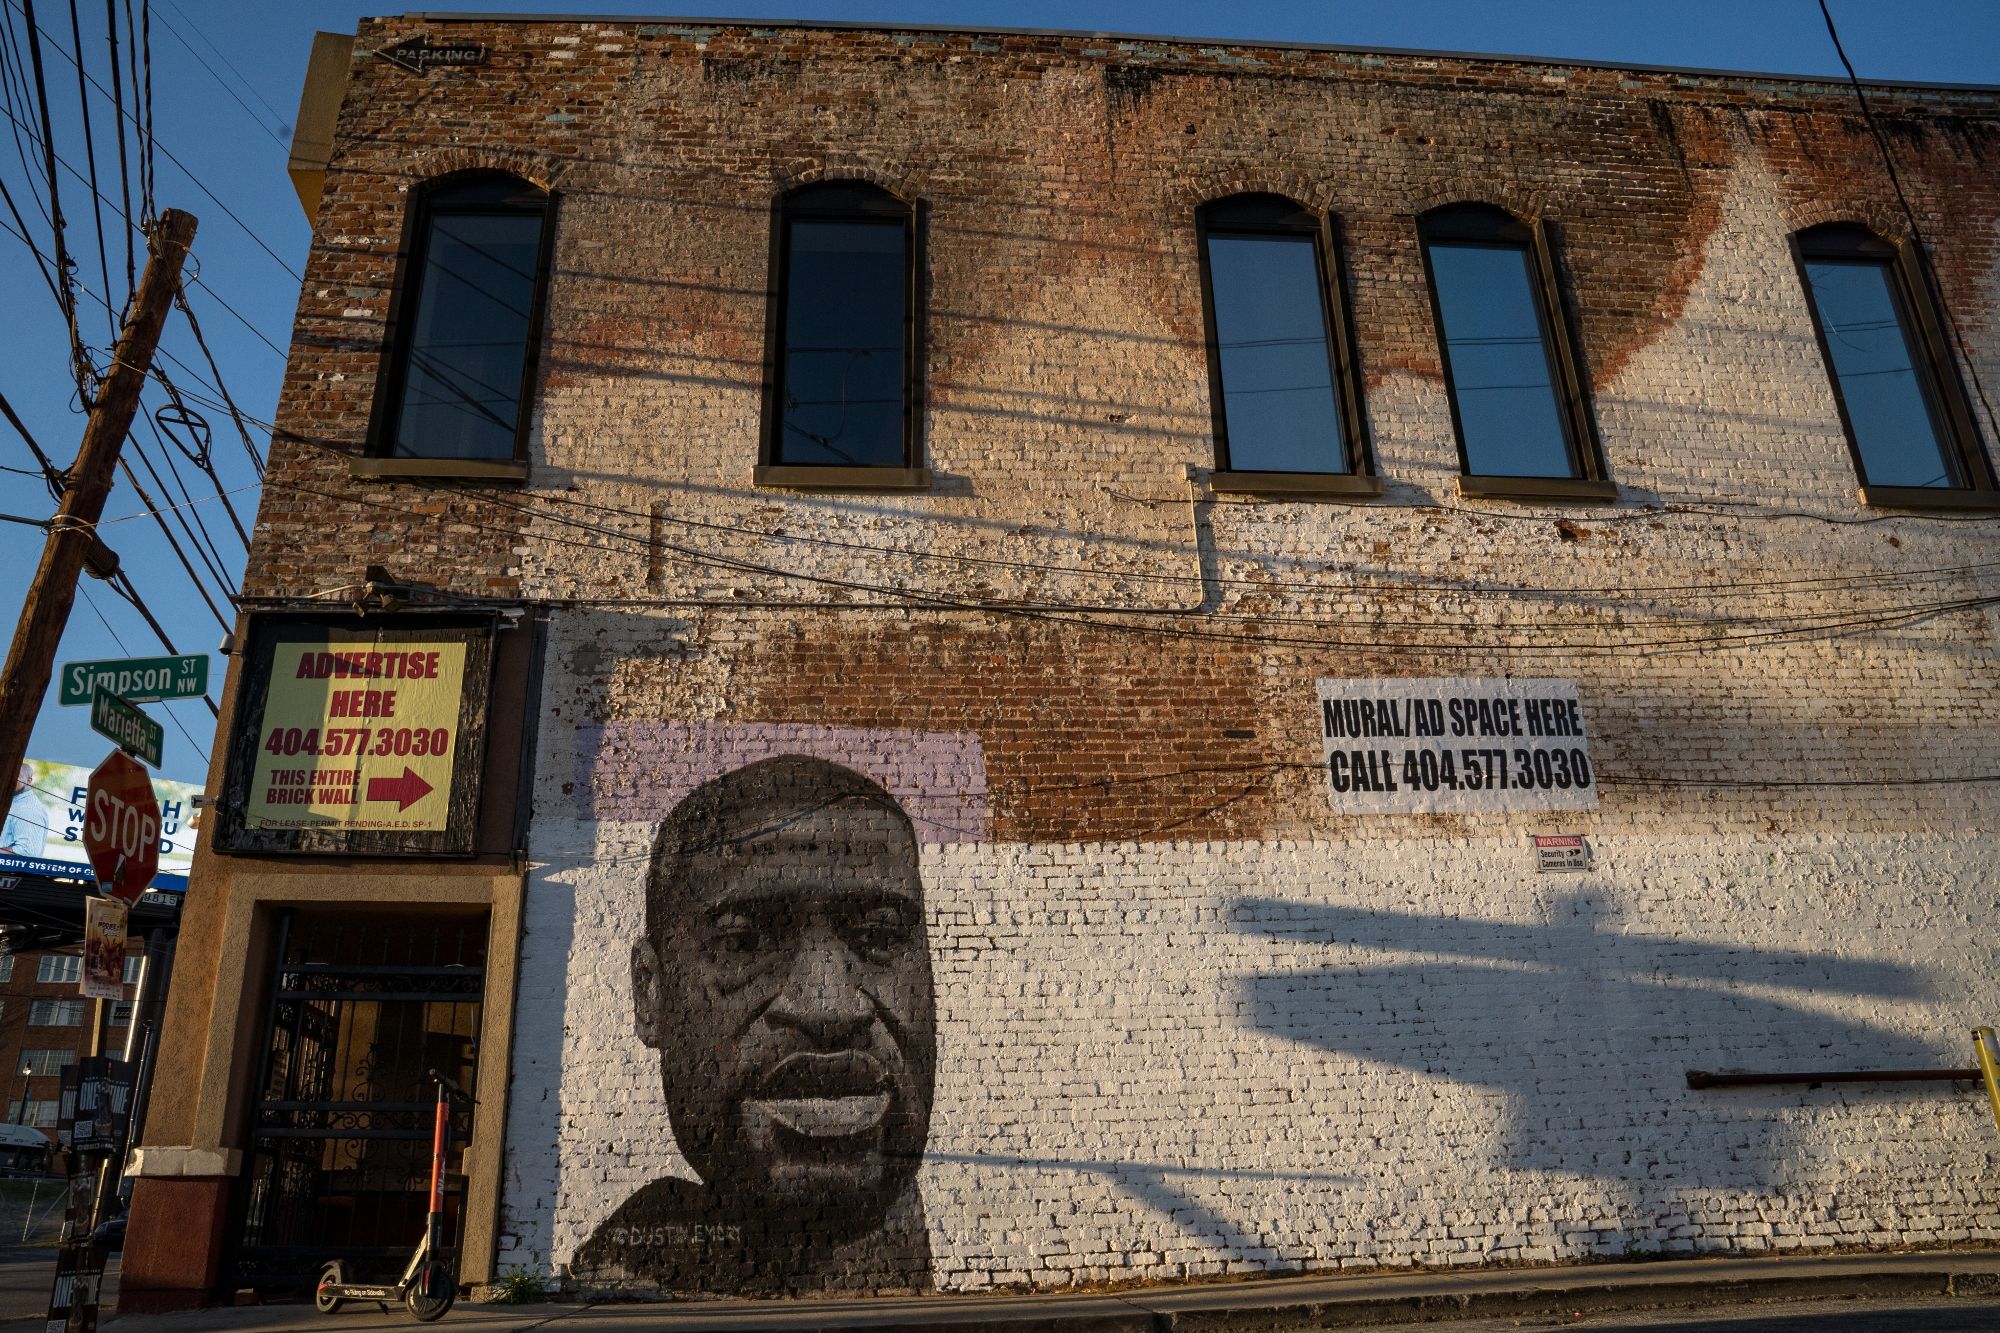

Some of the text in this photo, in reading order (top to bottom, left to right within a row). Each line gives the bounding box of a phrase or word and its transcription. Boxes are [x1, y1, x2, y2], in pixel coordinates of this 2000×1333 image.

[396, 49, 476, 61] PARKING
[296, 652, 440, 679] ADVERTISE
[70, 659, 197, 696] Simpson ST NW
[330, 690, 397, 717] HERE
[98, 694, 157, 761] Marietta ST NW
[1323, 697, 1583, 739] MURAL/AD SPACE HERE
[264, 728, 449, 756] 404.577.3030
[271, 769, 361, 786] THIS ENTIRE
[1330, 748, 1590, 793] CALL 404.577.3030
[266, 788, 358, 805] BRICK WALL
[91, 788, 156, 863] STOP
[260, 819, 279, 828] FOR
[413, 820, 432, 829] SP-1
[1537, 836, 1581, 847] WARNING
[1540, 849, 1564, 858] Security
[1541, 858, 1583, 868] Cameras In Use
[28, 862, 66, 873] SYSTEM
[68, 866, 82, 874] OF
